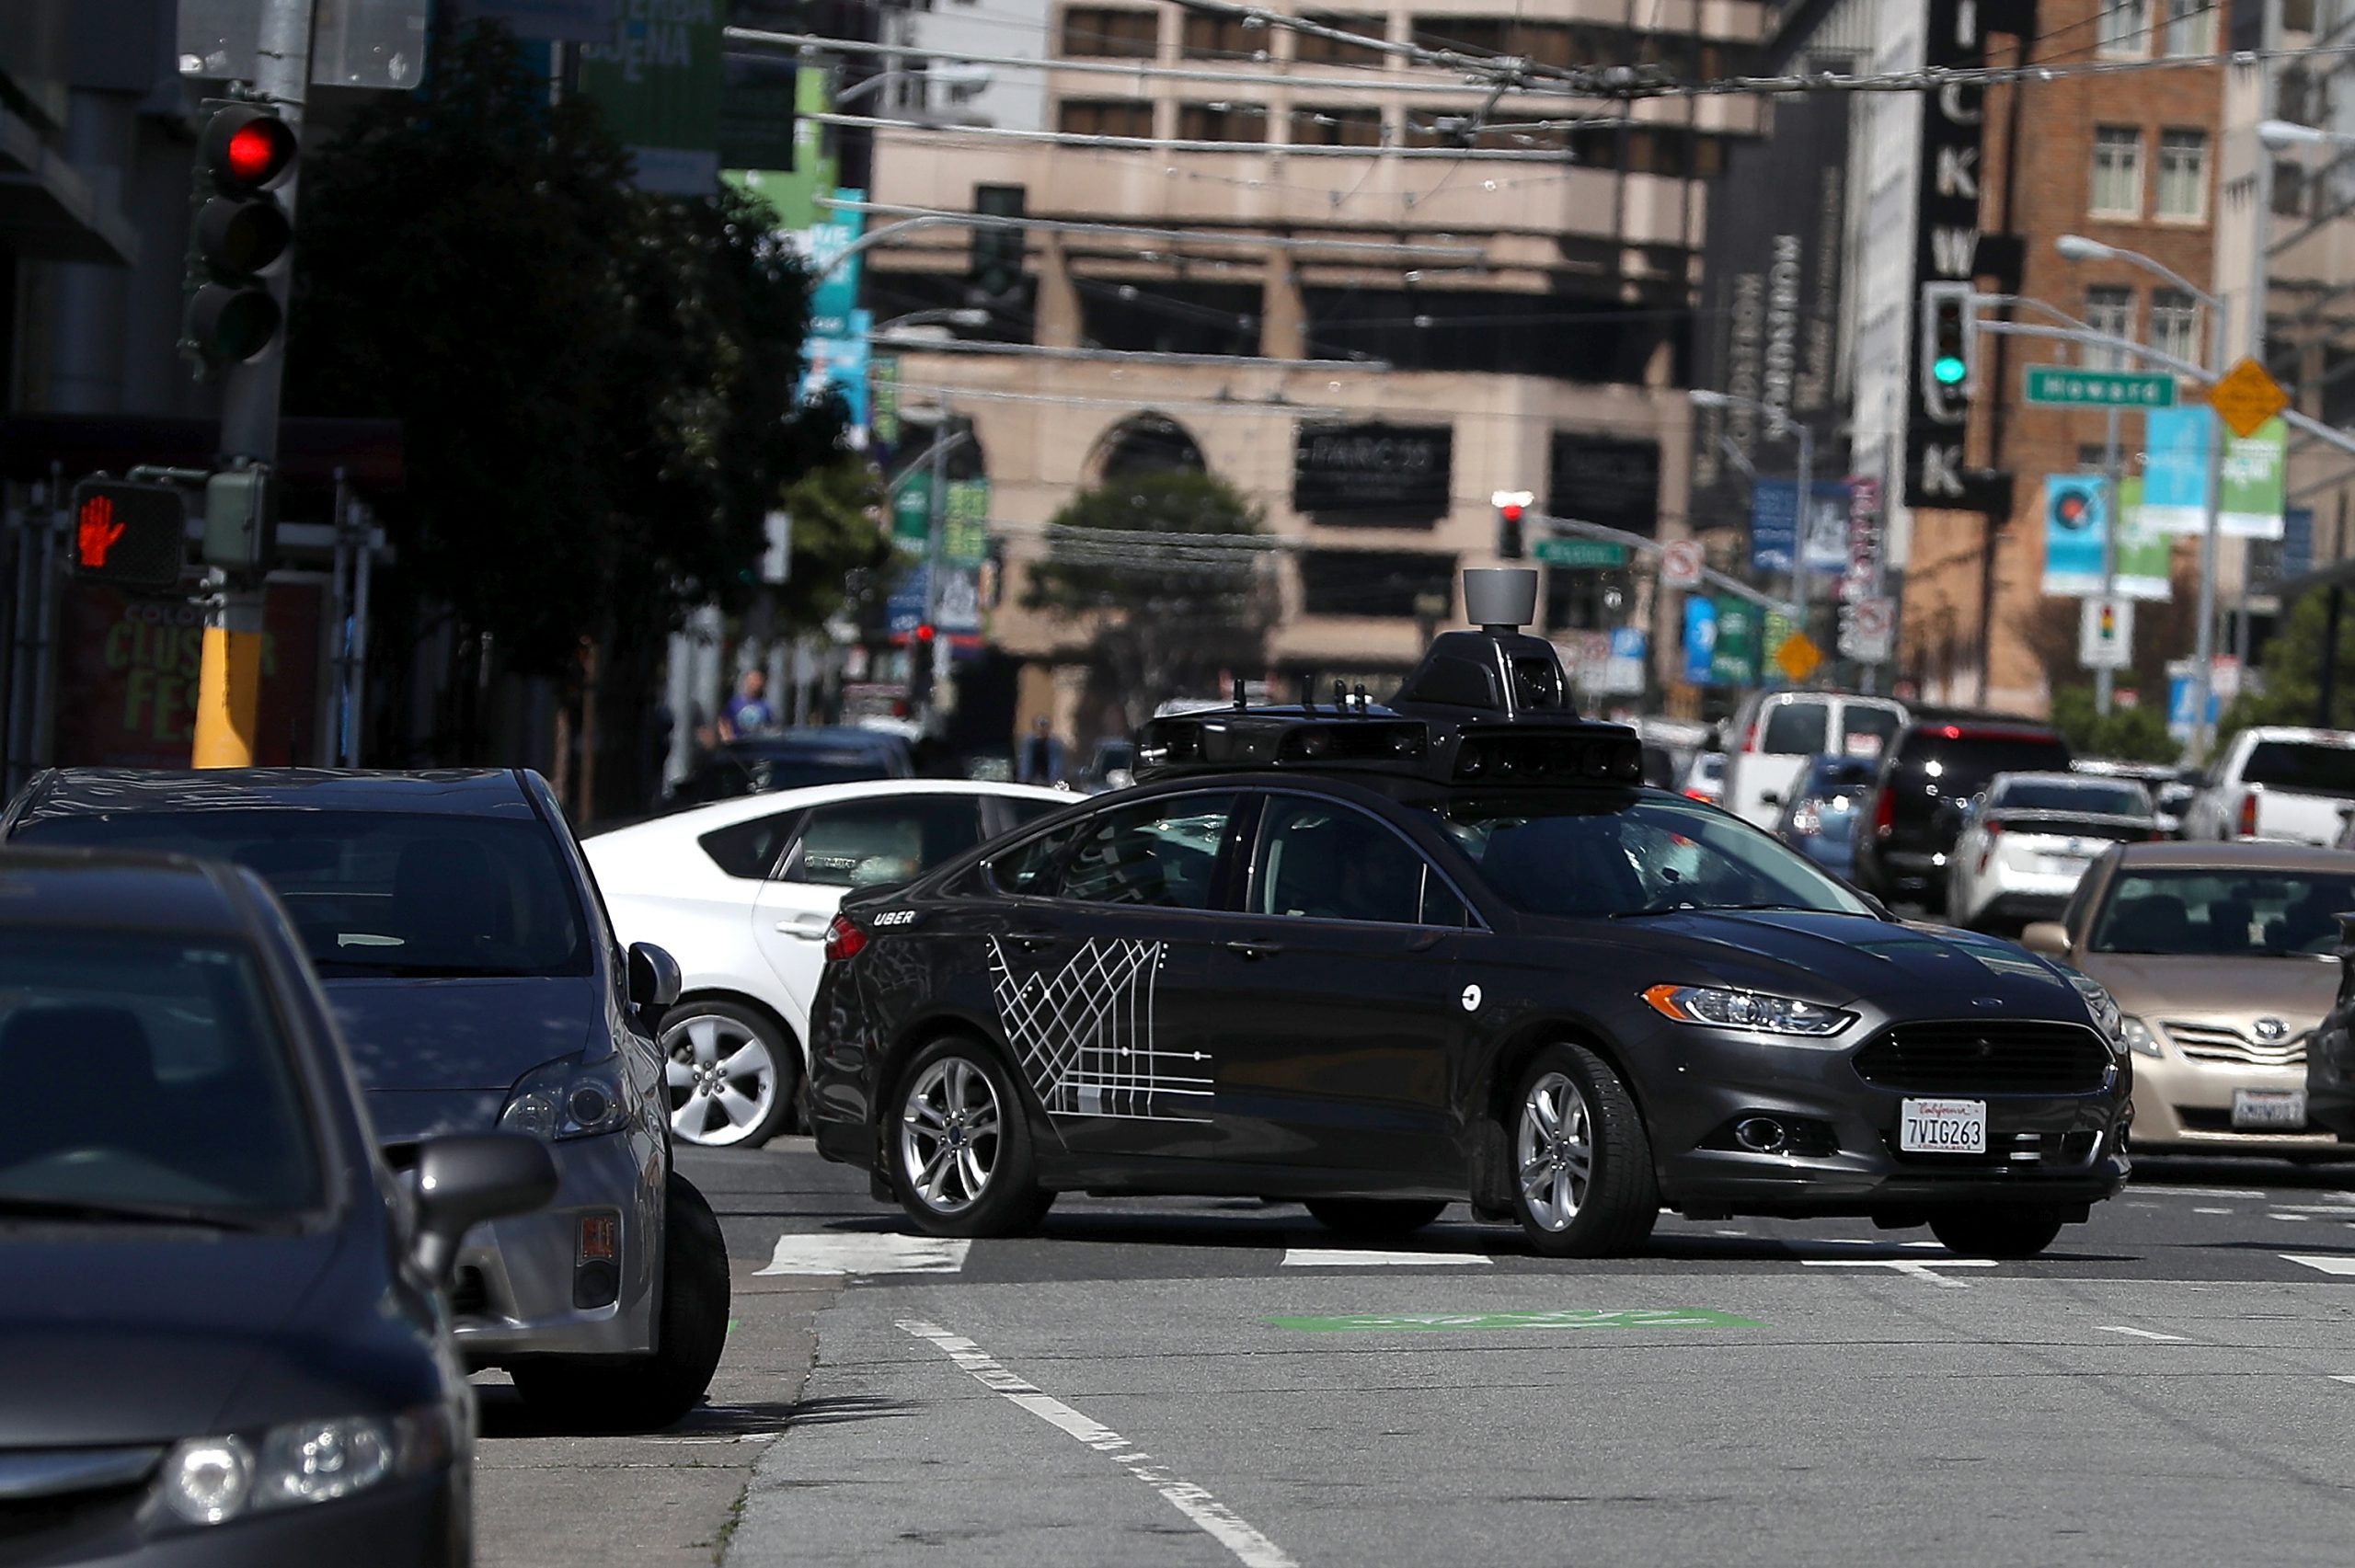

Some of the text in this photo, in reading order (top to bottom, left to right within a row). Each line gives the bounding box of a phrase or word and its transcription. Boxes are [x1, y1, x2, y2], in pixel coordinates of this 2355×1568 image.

[2043, 374, 2159, 399] Howard
[873, 910, 915, 926] UBER
[1918, 1103, 1970, 1117] California
[1907, 1118, 1981, 1145] 7VIG263
